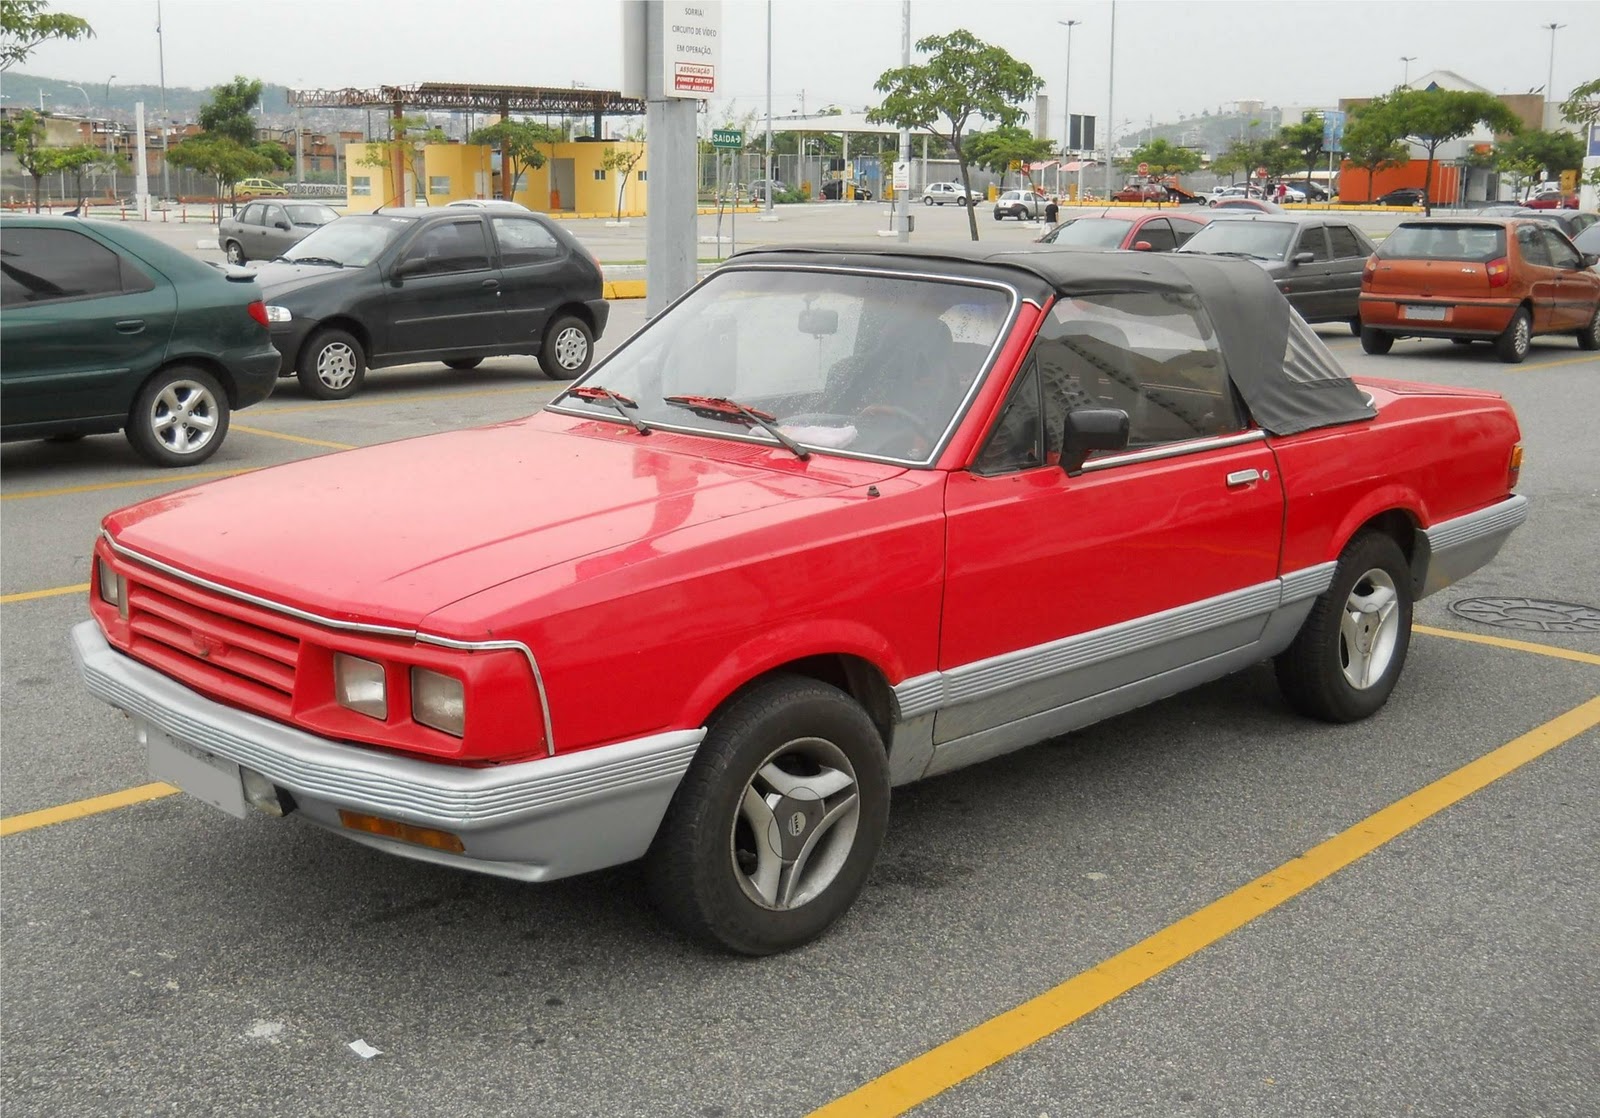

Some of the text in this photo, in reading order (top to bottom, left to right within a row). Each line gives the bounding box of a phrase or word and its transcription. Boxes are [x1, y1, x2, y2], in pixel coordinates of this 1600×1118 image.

[672, 24, 717, 37] CIRCUITO DE VÍDEO
[676, 44, 685, 52] EM
[680, 66, 710, 75] ASSOCIAÇÃO
[713, 132, 735, 143] SAÍDA
[307, 186, 331, 196] CARTAS
